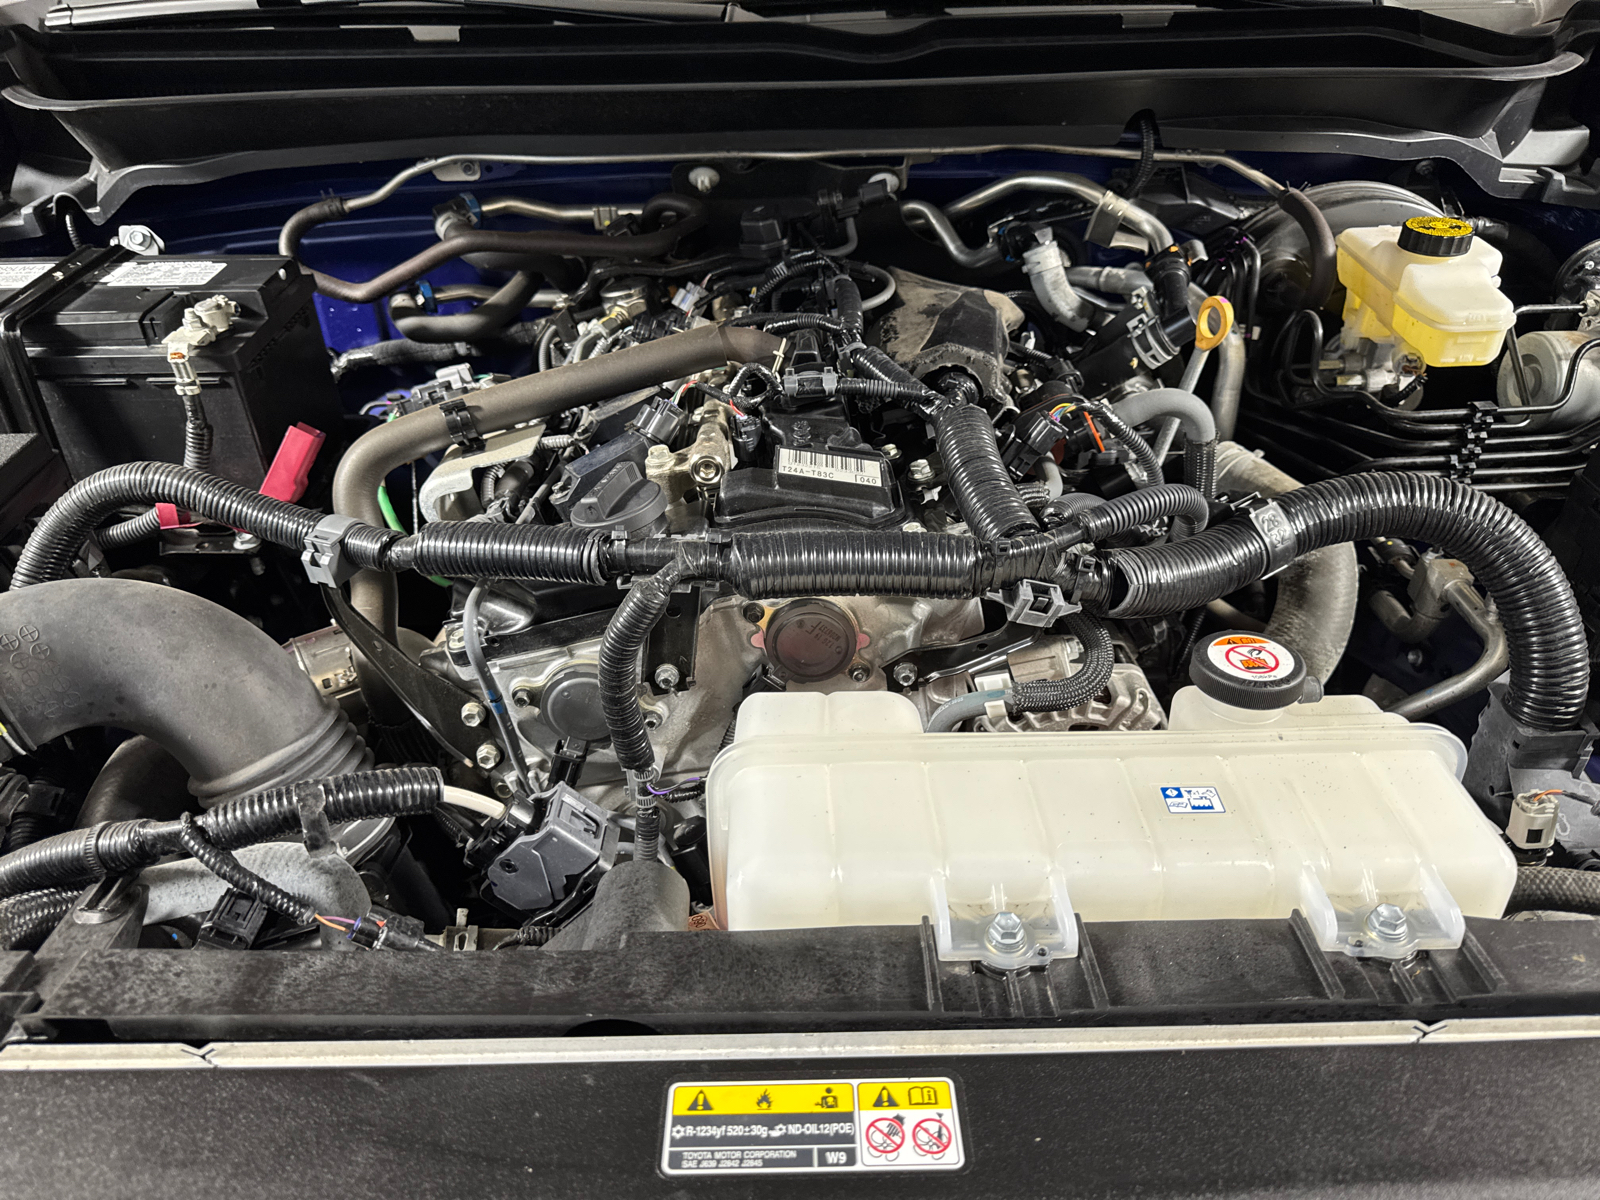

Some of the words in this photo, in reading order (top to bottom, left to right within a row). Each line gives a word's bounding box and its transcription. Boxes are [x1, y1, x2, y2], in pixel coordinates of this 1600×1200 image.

[781, 465, 835, 479] T24A-T83C
[1261, 511, 1280, 533] 28
[1270, 528, 1291, 549] 32
[685, 1124, 727, 1139] R-1234yf
[726, 1124, 769, 1138] 520±30g
[787, 1122, 855, 1136] ND-OIL12(POE)
[682, 1151, 712, 1160] TOYOTA
[713, 1151, 742, 1159] MOTOR
[743, 1149, 798, 1159] CORPORATION
[825, 1151, 847, 1165] W9
[681, 1160, 698, 1169] SAE
